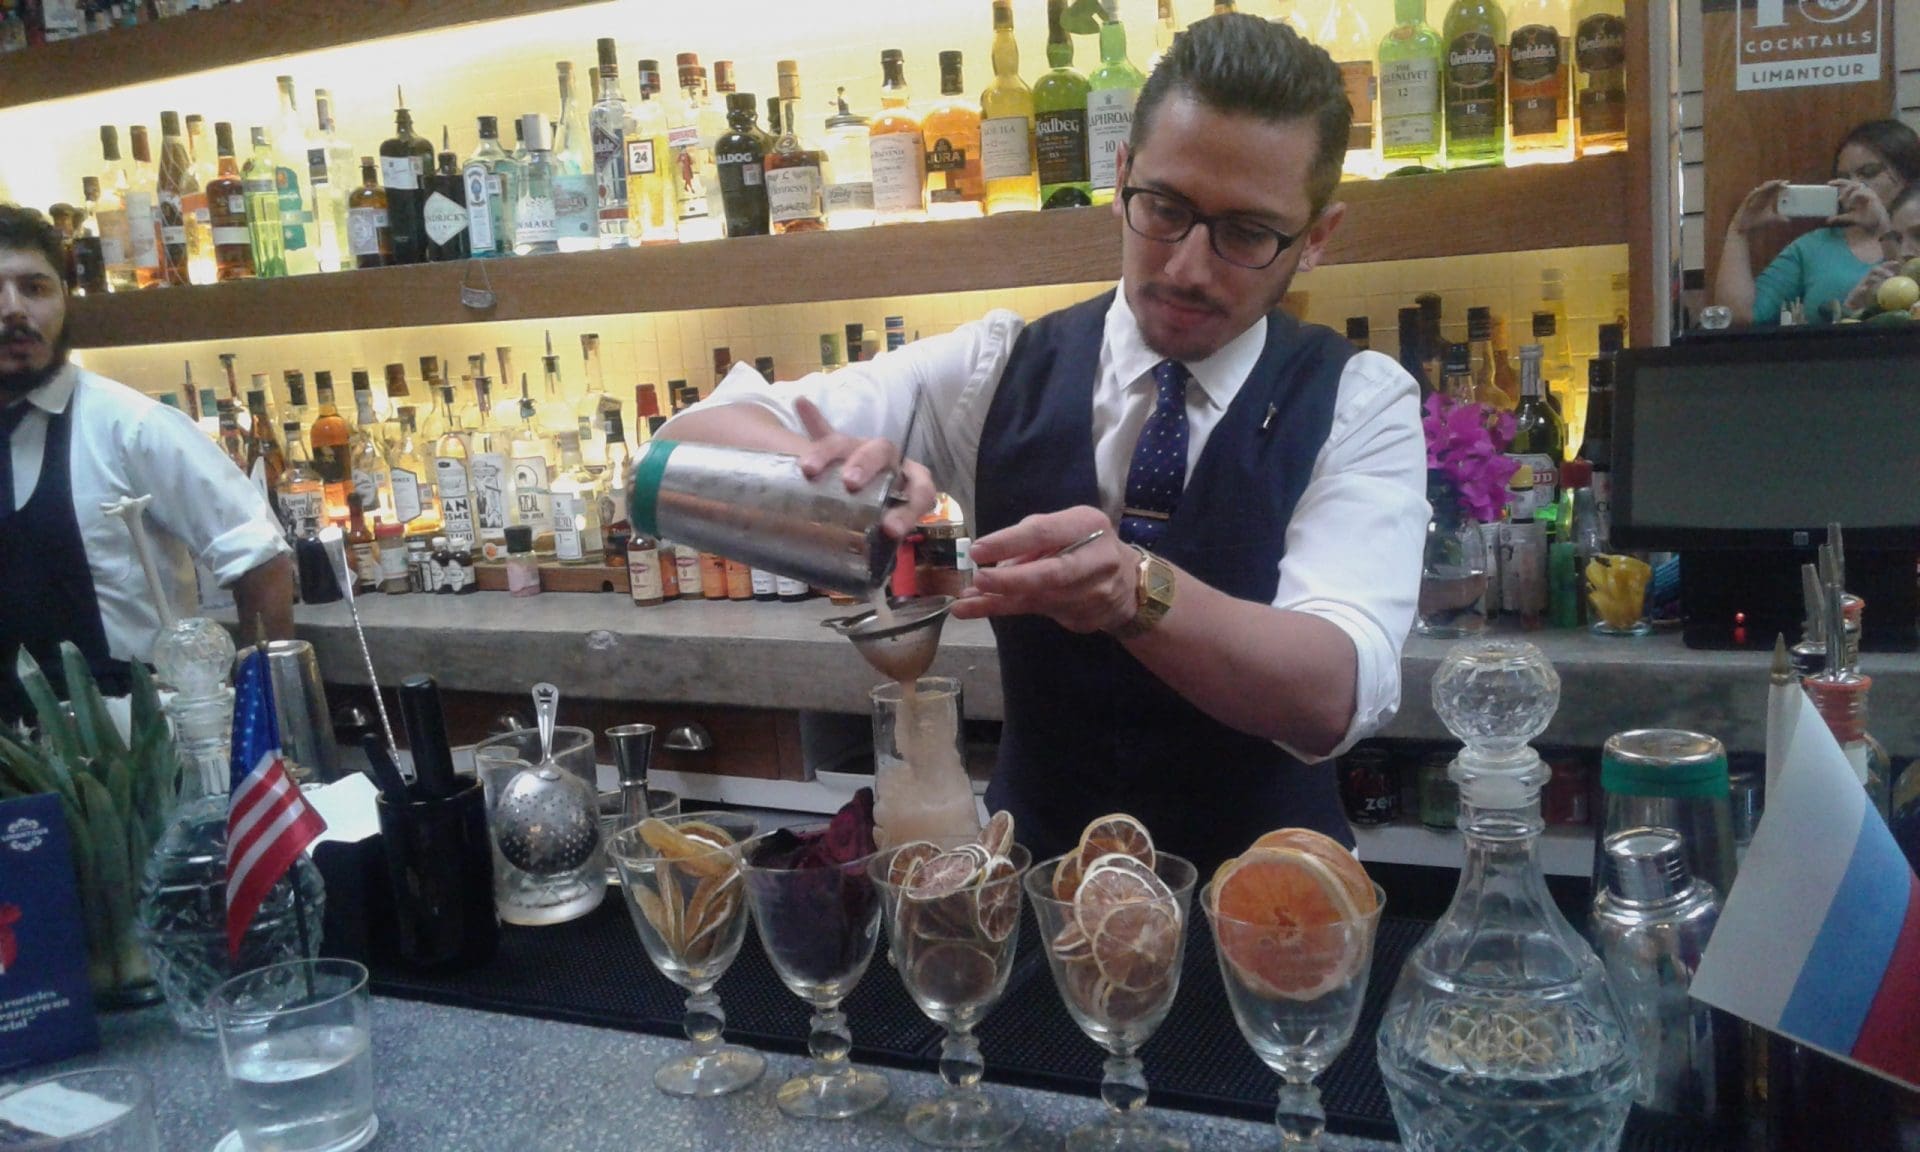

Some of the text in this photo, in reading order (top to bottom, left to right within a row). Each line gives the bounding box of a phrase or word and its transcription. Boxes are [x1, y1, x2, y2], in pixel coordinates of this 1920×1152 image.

[1745, 30, 1872, 54] COCKTAILS
[1382, 70, 1428, 83] GLENLIVET
[1752, 62, 1864, 84] LIMANTOUR
[1104, 139, 1116, 153] 10
[633, 151, 648, 164] 24
